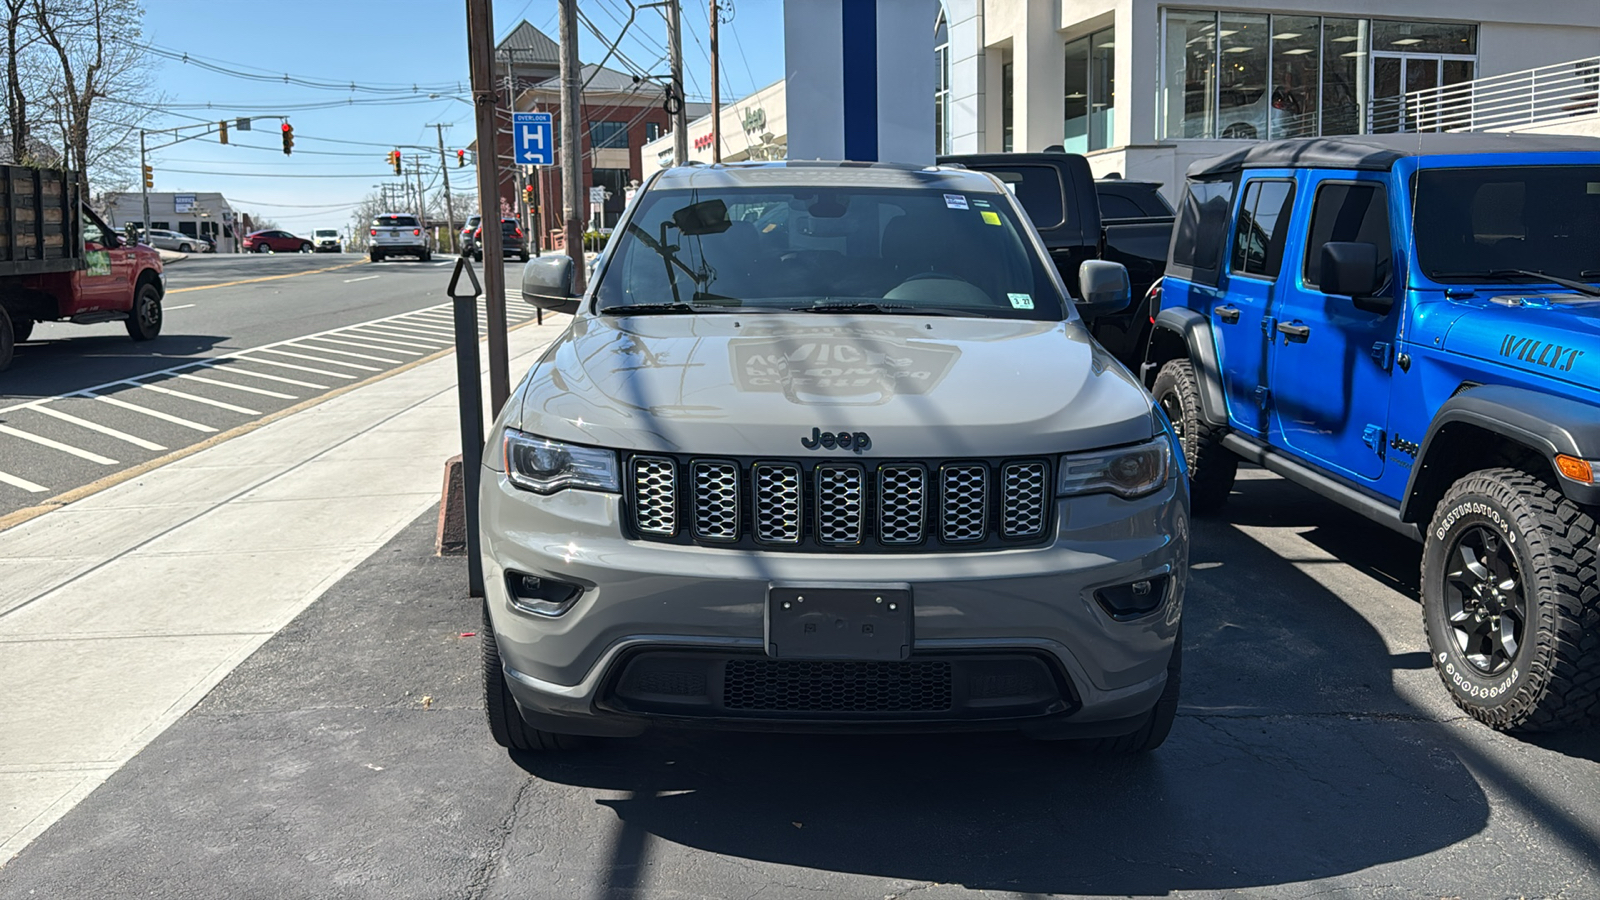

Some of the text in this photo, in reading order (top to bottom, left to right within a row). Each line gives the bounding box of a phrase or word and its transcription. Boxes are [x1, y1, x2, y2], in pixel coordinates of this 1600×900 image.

[743, 106, 766, 131] Jeep
[522, 125, 544, 149] H
[694, 132, 714, 149] DODG
[1499, 334, 1585, 372] WILLYS
[801, 427, 871, 453] Jeep
[1390, 433, 1420, 459] Jeep
[1436, 502, 1509, 541] DESTINATION
[1446, 668, 1519, 698] Firestone
